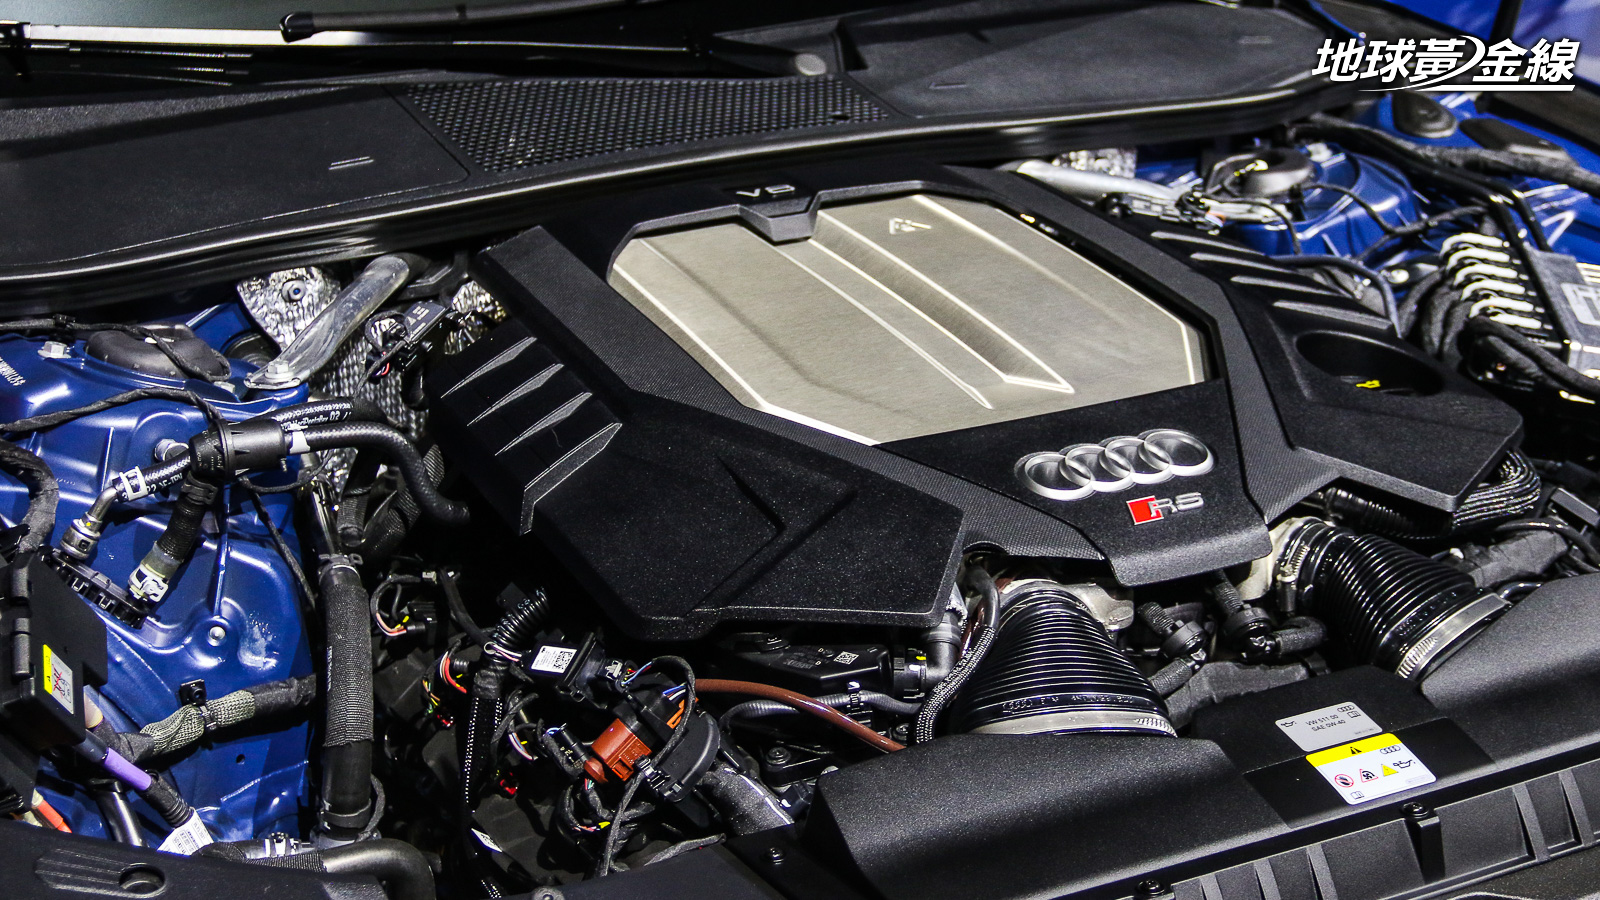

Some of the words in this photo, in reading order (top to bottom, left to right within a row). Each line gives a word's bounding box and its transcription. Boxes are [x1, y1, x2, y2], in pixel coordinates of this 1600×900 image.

[1143, 491, 1204, 518] RS
[1305, 718, 1317, 726] VW
[1317, 716, 1329, 724] 511
[1325, 719, 1346, 728] 0W-40
